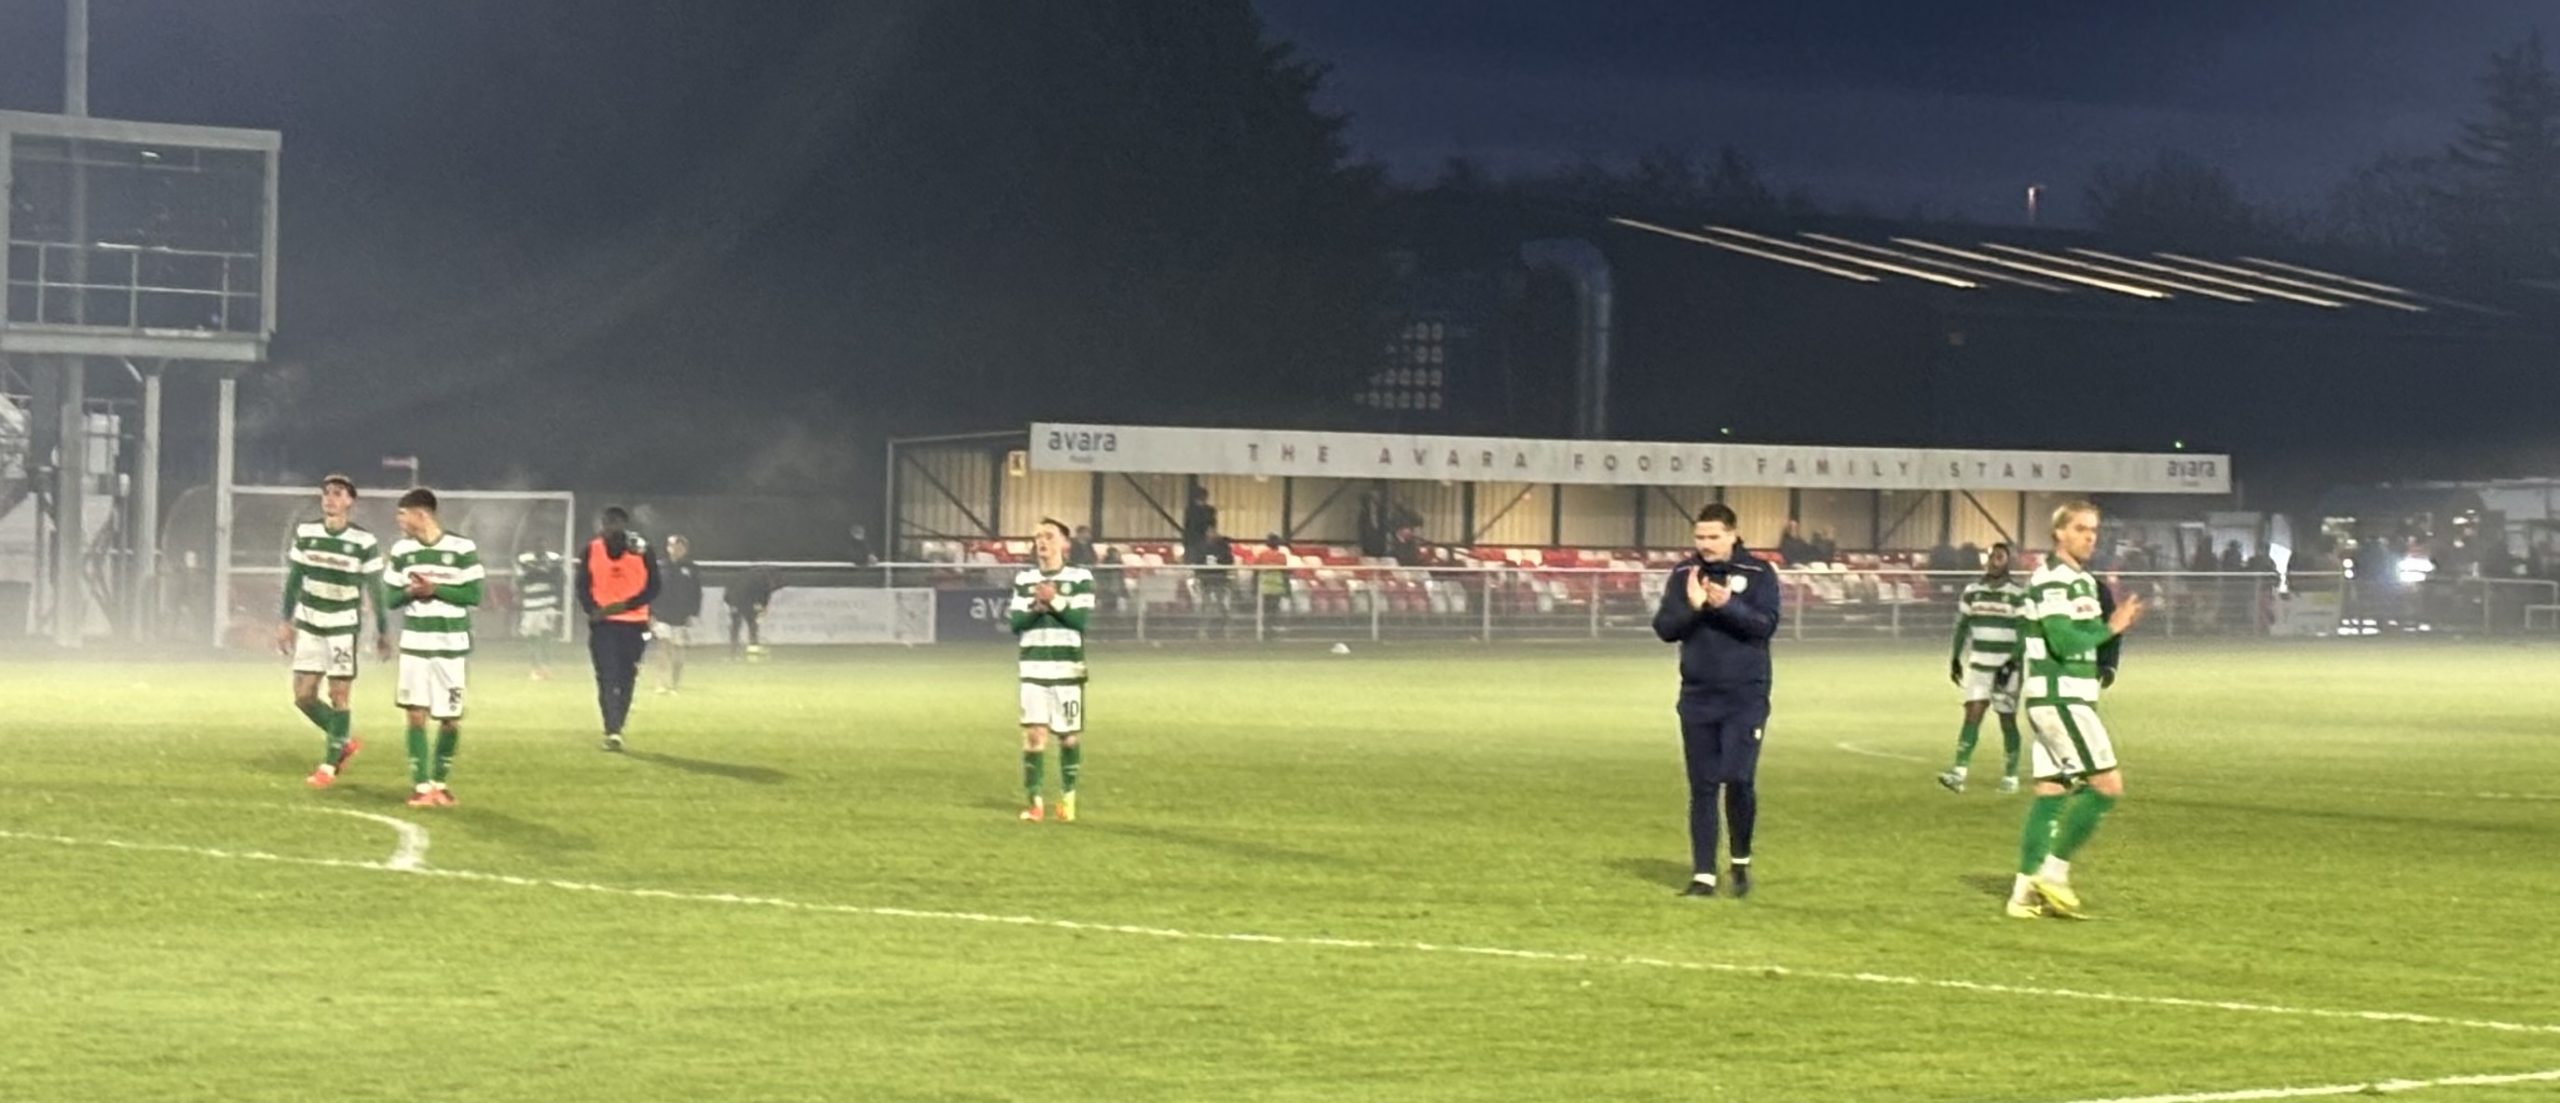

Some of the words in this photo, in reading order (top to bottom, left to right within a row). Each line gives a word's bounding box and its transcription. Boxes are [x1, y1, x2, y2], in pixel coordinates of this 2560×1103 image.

[1048, 431, 1117, 452] avara
[1248, 443, 1328, 463] THE
[1377, 447, 1527, 468] AVARA
[1574, 453, 1713, 473] FOODS
[1757, 457, 1909, 476] FAMILY
[1950, 461, 2071, 480] STAND
[2167, 460, 2217, 478] avara
[1062, 700, 1080, 718] 10
